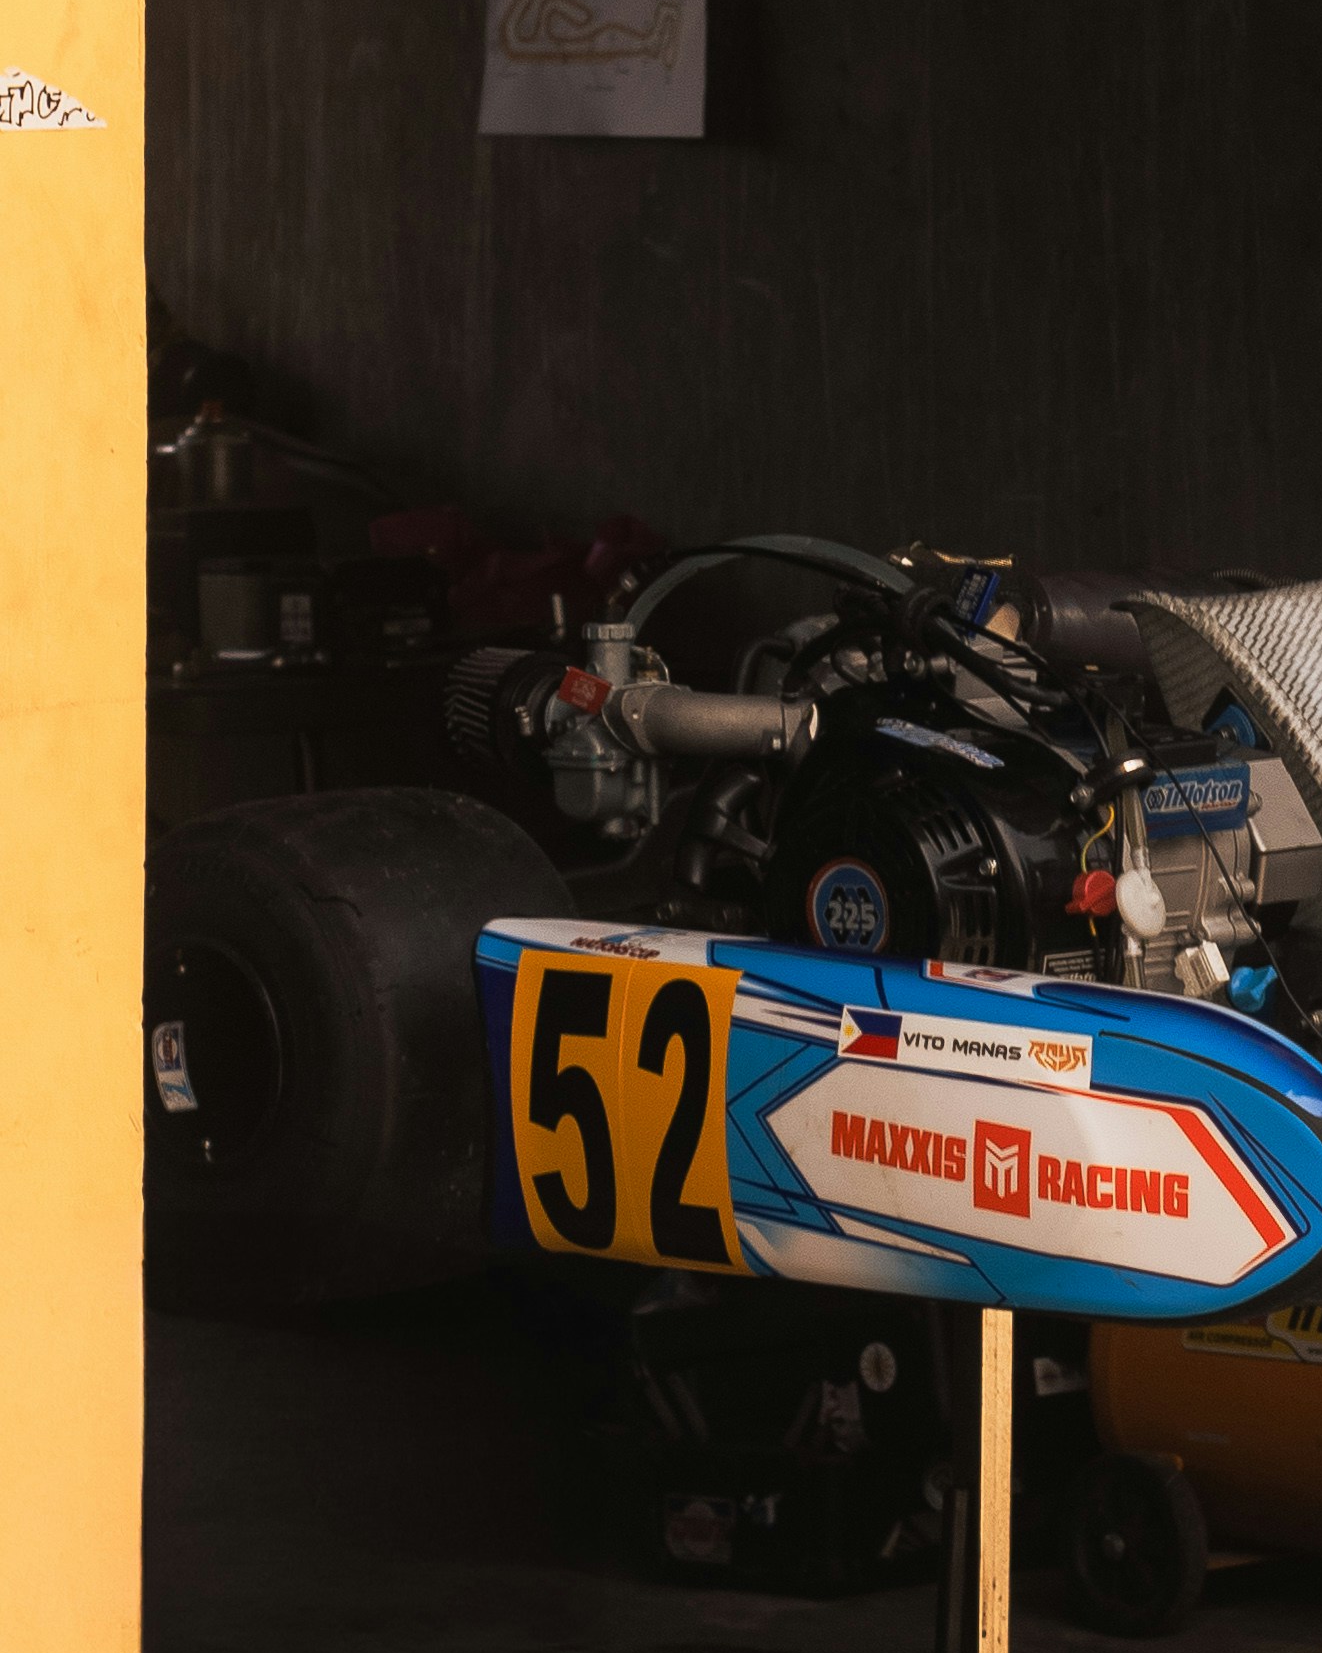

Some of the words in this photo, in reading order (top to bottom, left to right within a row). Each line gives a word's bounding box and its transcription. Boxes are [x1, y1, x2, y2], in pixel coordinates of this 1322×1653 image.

[828, 899, 876, 932] 225
[903, 1032, 945, 1051] VITO
[952, 1037, 1022, 1061] MANAS
[529, 967, 734, 1267] 52
[832, 1110, 967, 1182] MAXXIS
[1037, 1154, 1190, 1219] RACING
